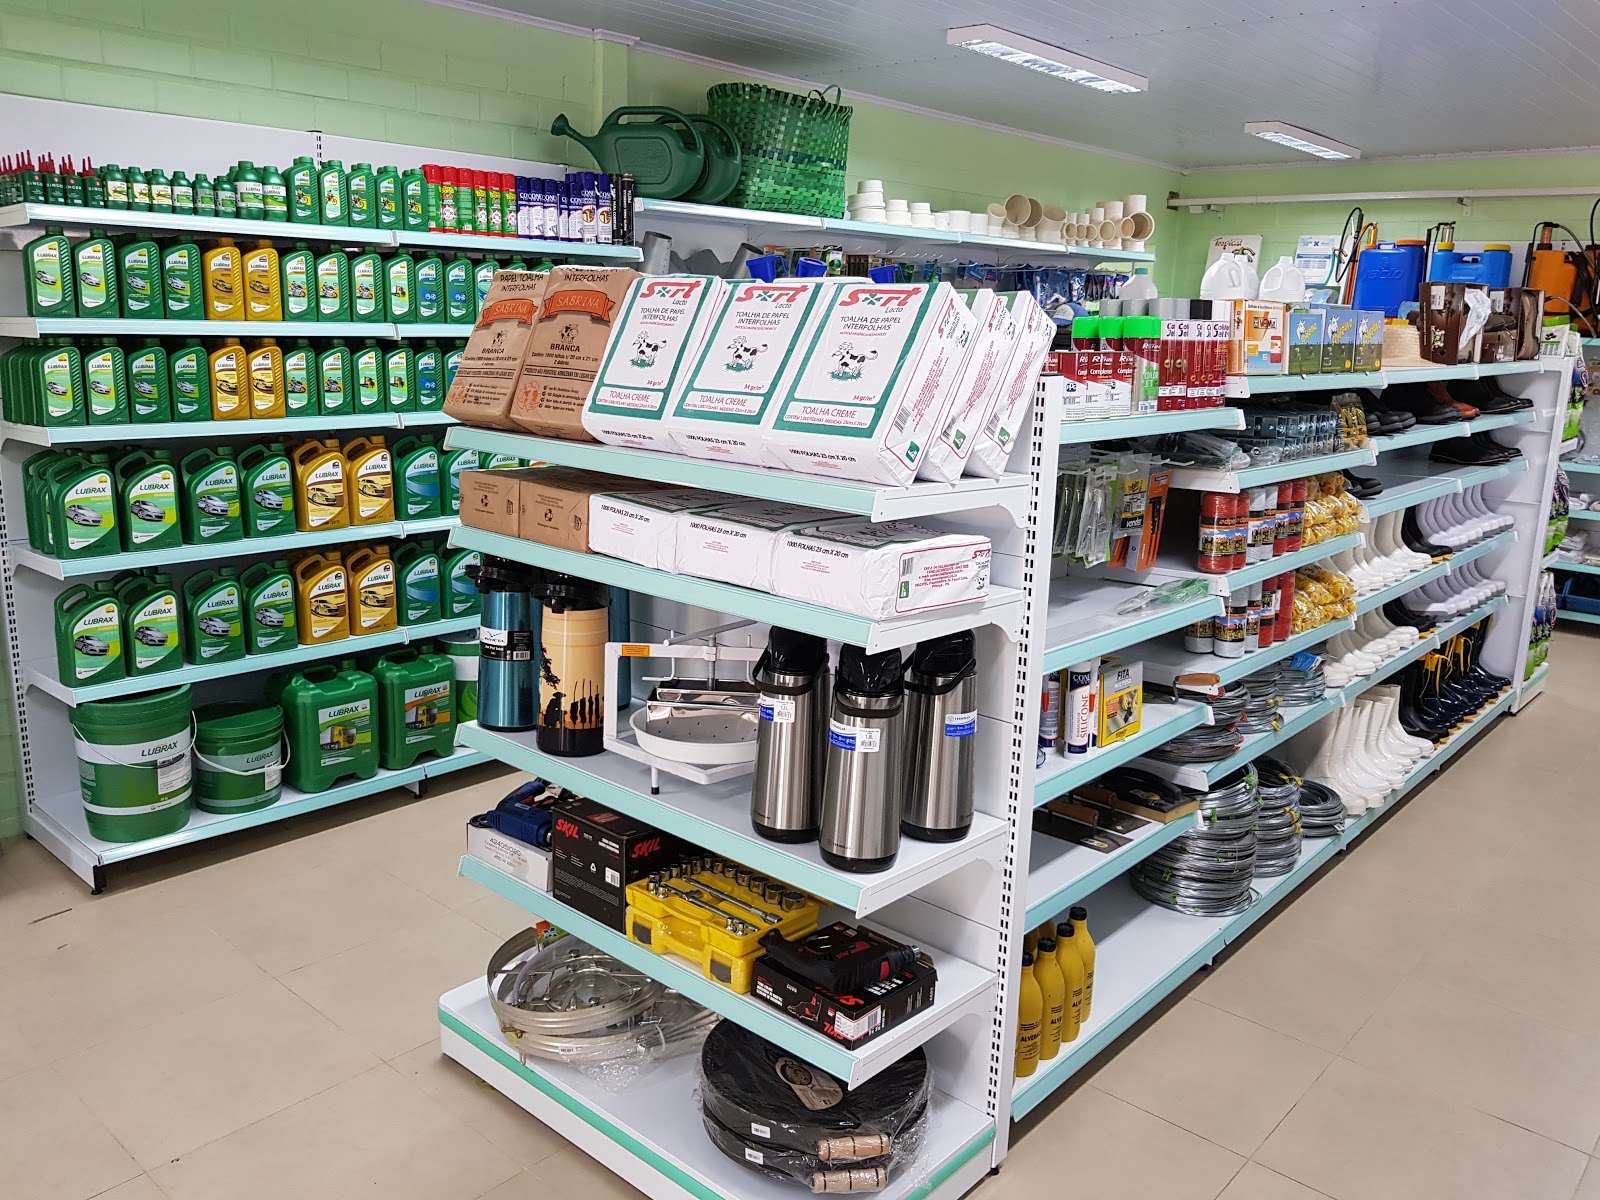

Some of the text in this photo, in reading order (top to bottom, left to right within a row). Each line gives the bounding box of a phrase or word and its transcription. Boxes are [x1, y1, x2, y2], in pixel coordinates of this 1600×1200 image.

[1213, 237, 1243, 250] Tropical
[500, 273, 544, 282] PAPEL TOALHA
[563, 273, 609, 283] INTERFOLHAS
[500, 284, 537, 292] INTERFOLHAS
[556, 296, 600, 308] SABRINA
[672, 298, 688, 306] Lacto
[774, 301, 793, 309] Lacto
[493, 303, 528, 315] SABRINA
[884, 306, 904, 314] Lacto
[641, 313, 679, 322] INTERFOLHAS
[737, 317, 781, 326] INTERFOLHAS
[870, 316, 880, 324] DE
[880, 317, 903, 325] PAPEL
[842, 323, 892, 331] INTERFOLHAS
[550, 343, 580, 353] BRANCA
[1066, 382, 1077, 392] PPG
[608, 390, 651, 402] TOALHA CREME
[699, 395, 748, 407] TOALHA CREME
[801, 405, 858, 419] TOALHA CREME
[365, 463, 388, 471] LUBRAX
[413, 462, 436, 470] LUBRAX
[457, 459, 477, 467] LUBRAX
[261, 473, 287, 481] LUBRAX
[315, 471, 339, 479] LUBRAX
[139, 483, 170, 491] LUBRAX
[205, 478, 233, 486] LUBRAX
[75, 487, 107, 495] LUBRAX
[700, 524, 717, 532] FOLHAS
[786, 540, 797, 548] 1000
[797, 542, 816, 552] FOLHAS
[413, 568, 436, 576] LUBRAX
[367, 573, 390, 582] LUBRAX
[317, 582, 342, 591] LUBRAX
[262, 590, 289, 600] LUBRAX
[207, 599, 235, 608] LUBRAX
[143, 607, 172, 617] LUBRAX
[83, 616, 114, 626] LUBRAX
[1116, 668, 1130, 680] FITA
[1113, 677, 1132, 689] MULTIUSO
[414, 686, 442, 698] LUBRAX
[328, 704, 360, 718] LUBRAX
[1080, 694, 1090, 739] SILICONE
[141, 740, 179, 757] LUBRAX
[246, 750, 274, 764] LUBRAX
[555, 818, 580, 839] SKIL
[631, 837, 662, 859] SKIL
[1020, 1032, 1041, 1043] ALVENA
